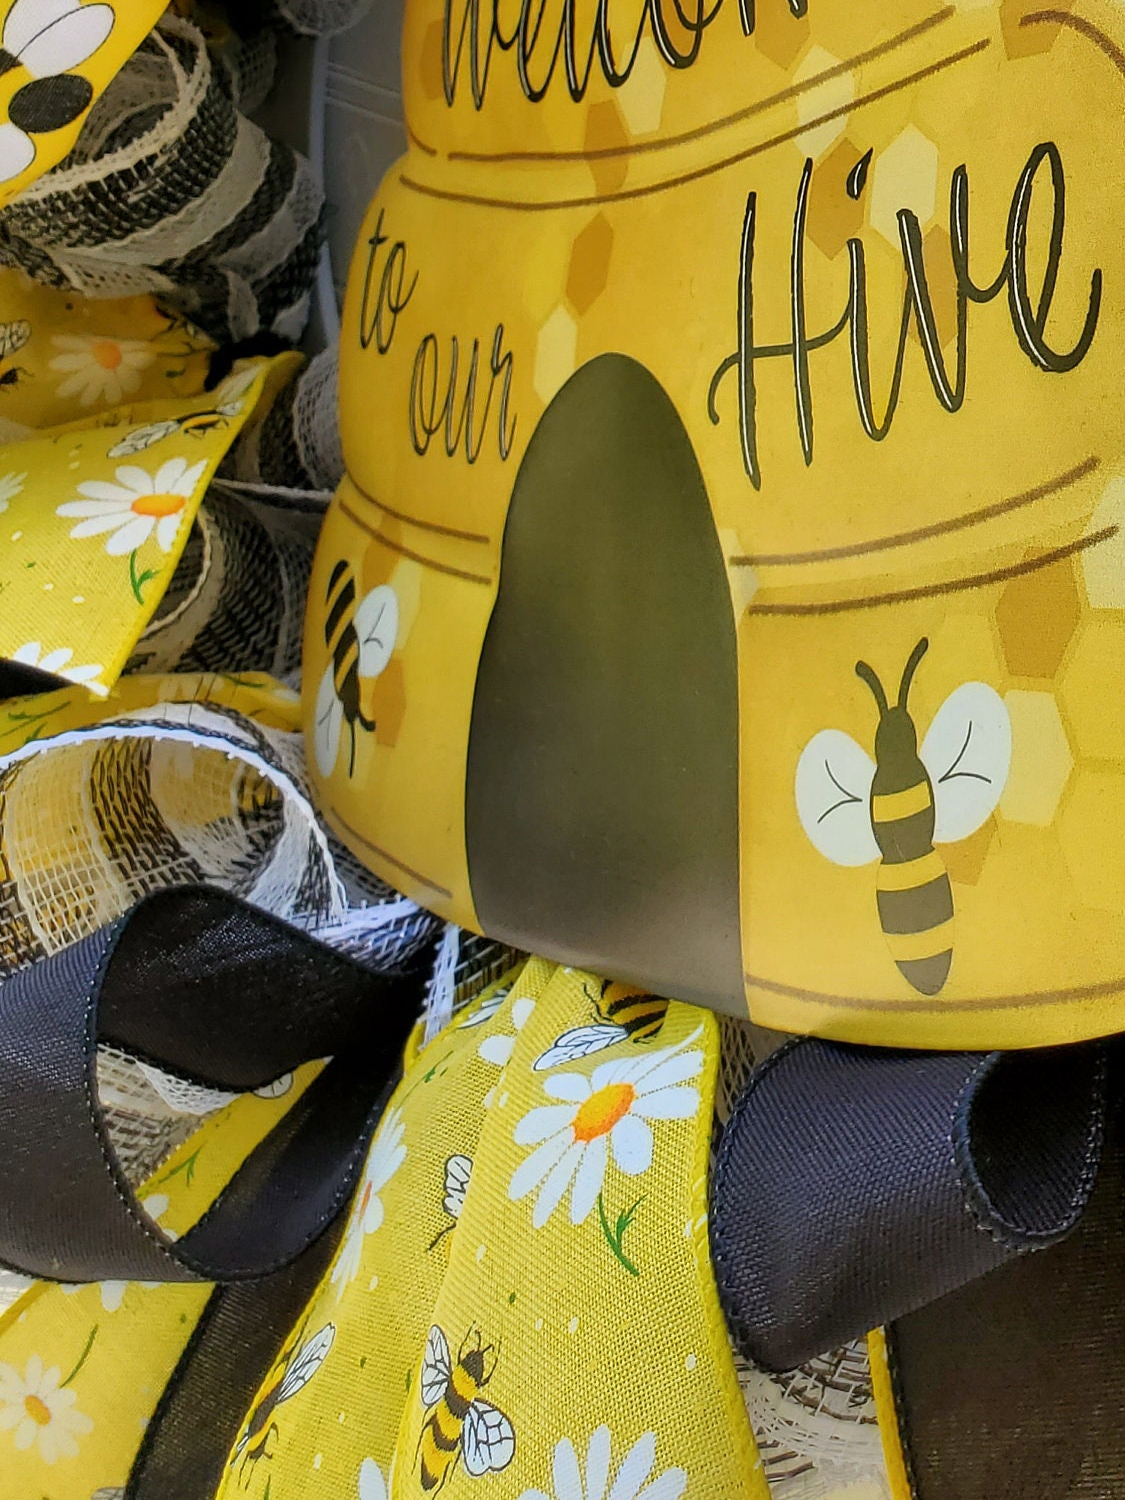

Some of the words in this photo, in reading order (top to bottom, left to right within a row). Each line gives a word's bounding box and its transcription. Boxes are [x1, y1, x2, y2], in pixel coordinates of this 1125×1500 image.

[357, 207, 418, 356] to
[408, 322, 518, 465] our
[708, 140, 1103, 491] Hive
